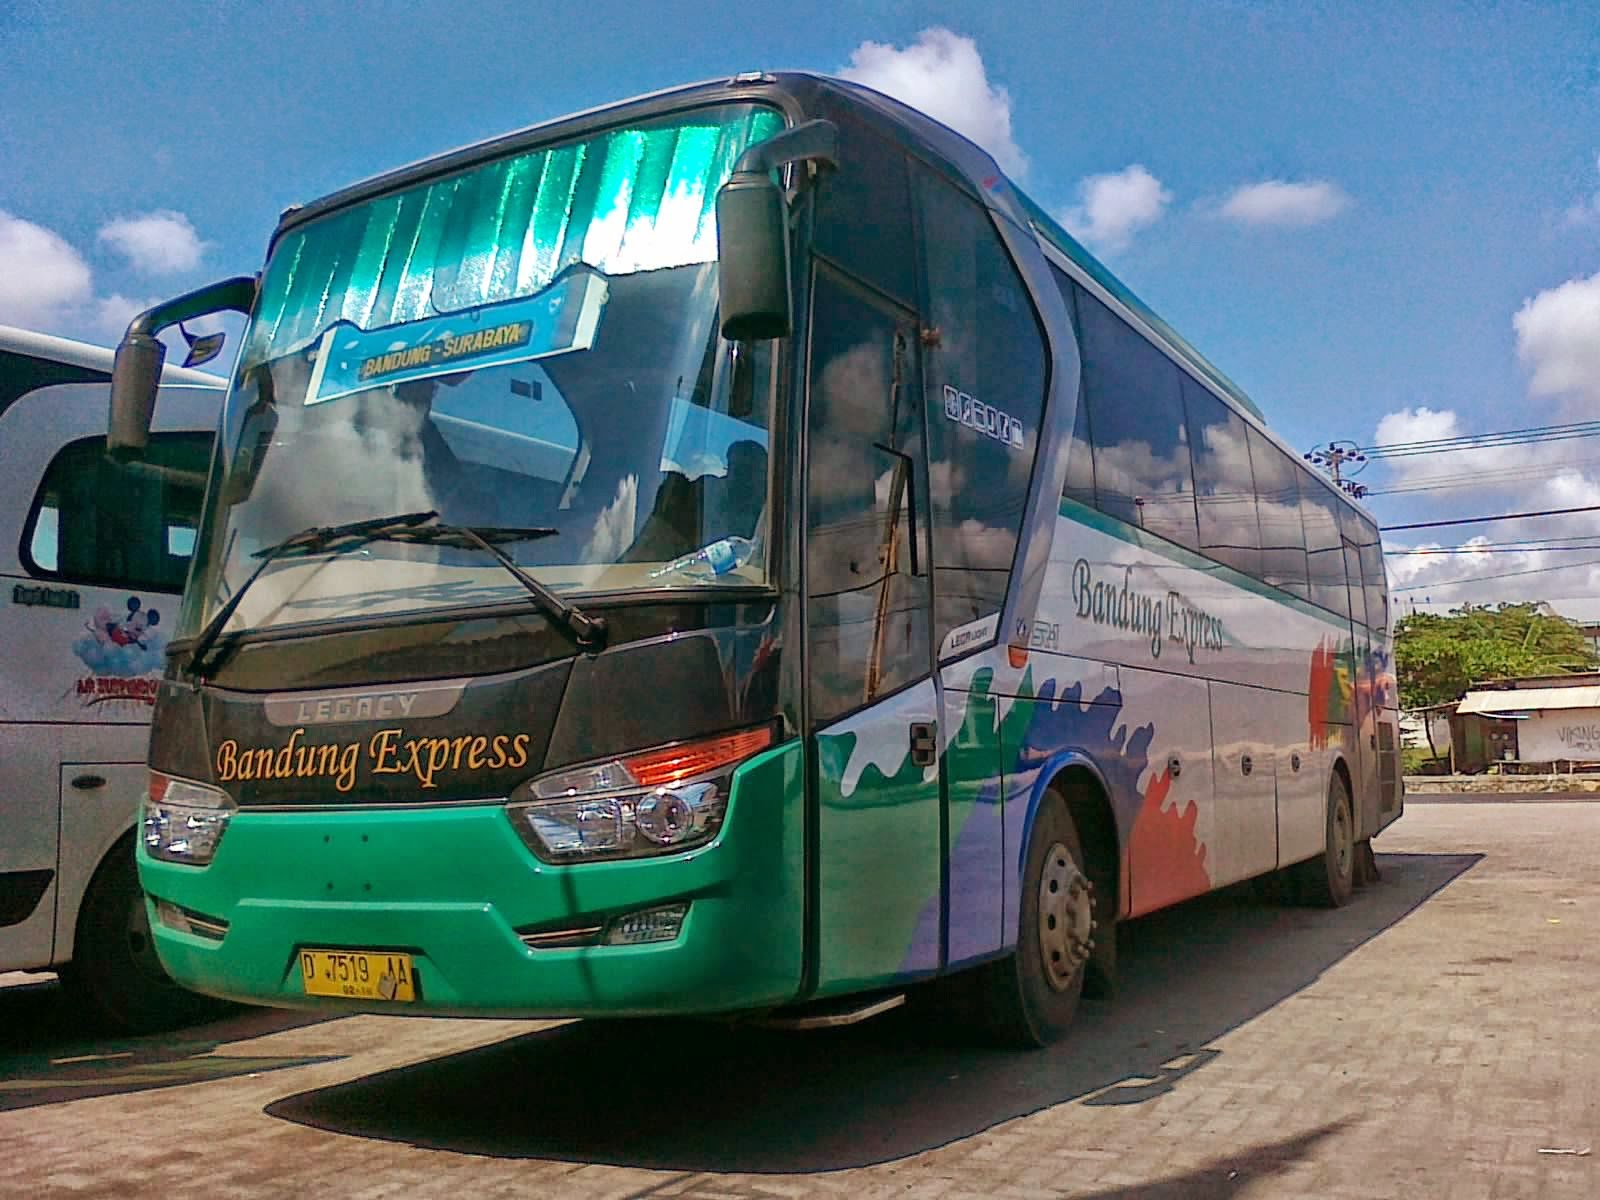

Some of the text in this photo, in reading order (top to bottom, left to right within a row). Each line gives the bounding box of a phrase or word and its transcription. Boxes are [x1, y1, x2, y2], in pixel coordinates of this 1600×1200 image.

[363, 345, 431, 377] BANDUNG
[443, 323, 521, 357] SURABAYA
[1072, 558, 1223, 665] Bandung Express
[297, 693, 417, 721] LEGACY
[216, 727, 530, 793] Bandung Express
[303, 953, 314, 979] D
[327, 955, 369, 982] 7519
